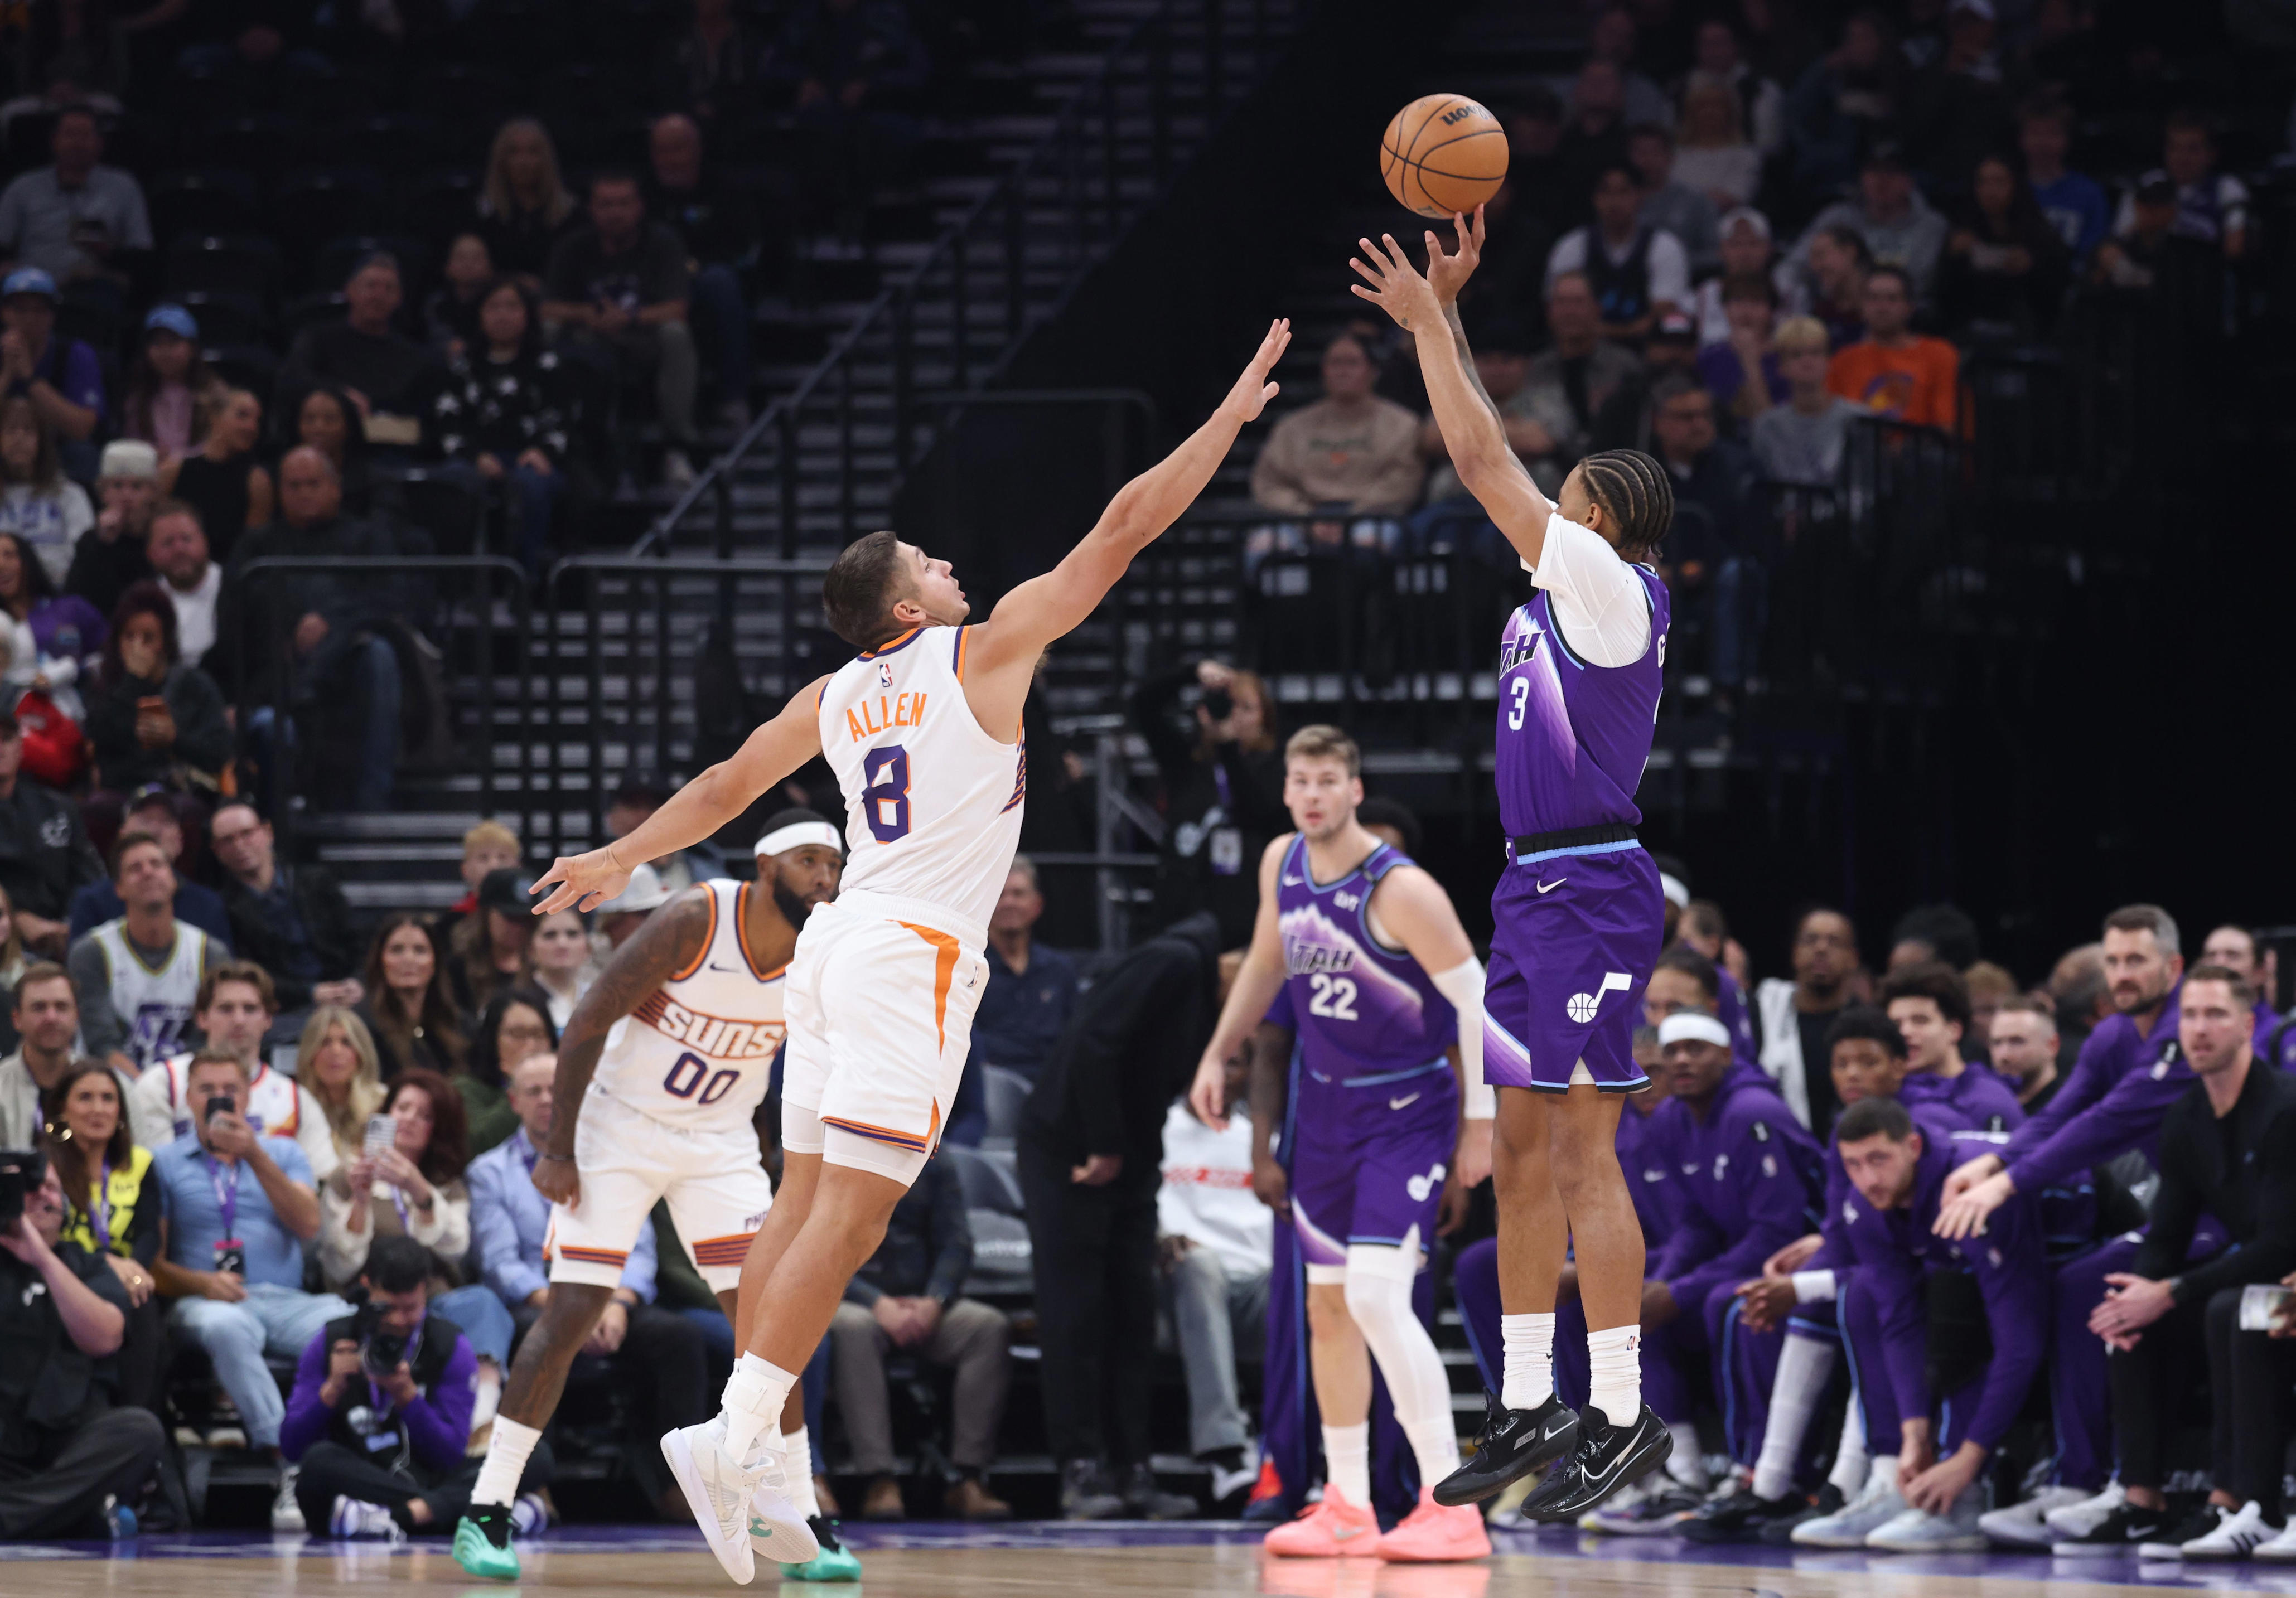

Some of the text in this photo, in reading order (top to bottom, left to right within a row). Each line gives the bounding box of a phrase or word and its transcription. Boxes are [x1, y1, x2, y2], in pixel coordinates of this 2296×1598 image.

[847, 692, 927, 743] ALLEN
[1508, 676, 1529, 731] 3
[862, 744, 912, 845] 8
[1309, 973, 1359, 1021] 22
[657, 1001, 786, 1058] SUNS
[664, 1052, 741, 1105] 00
